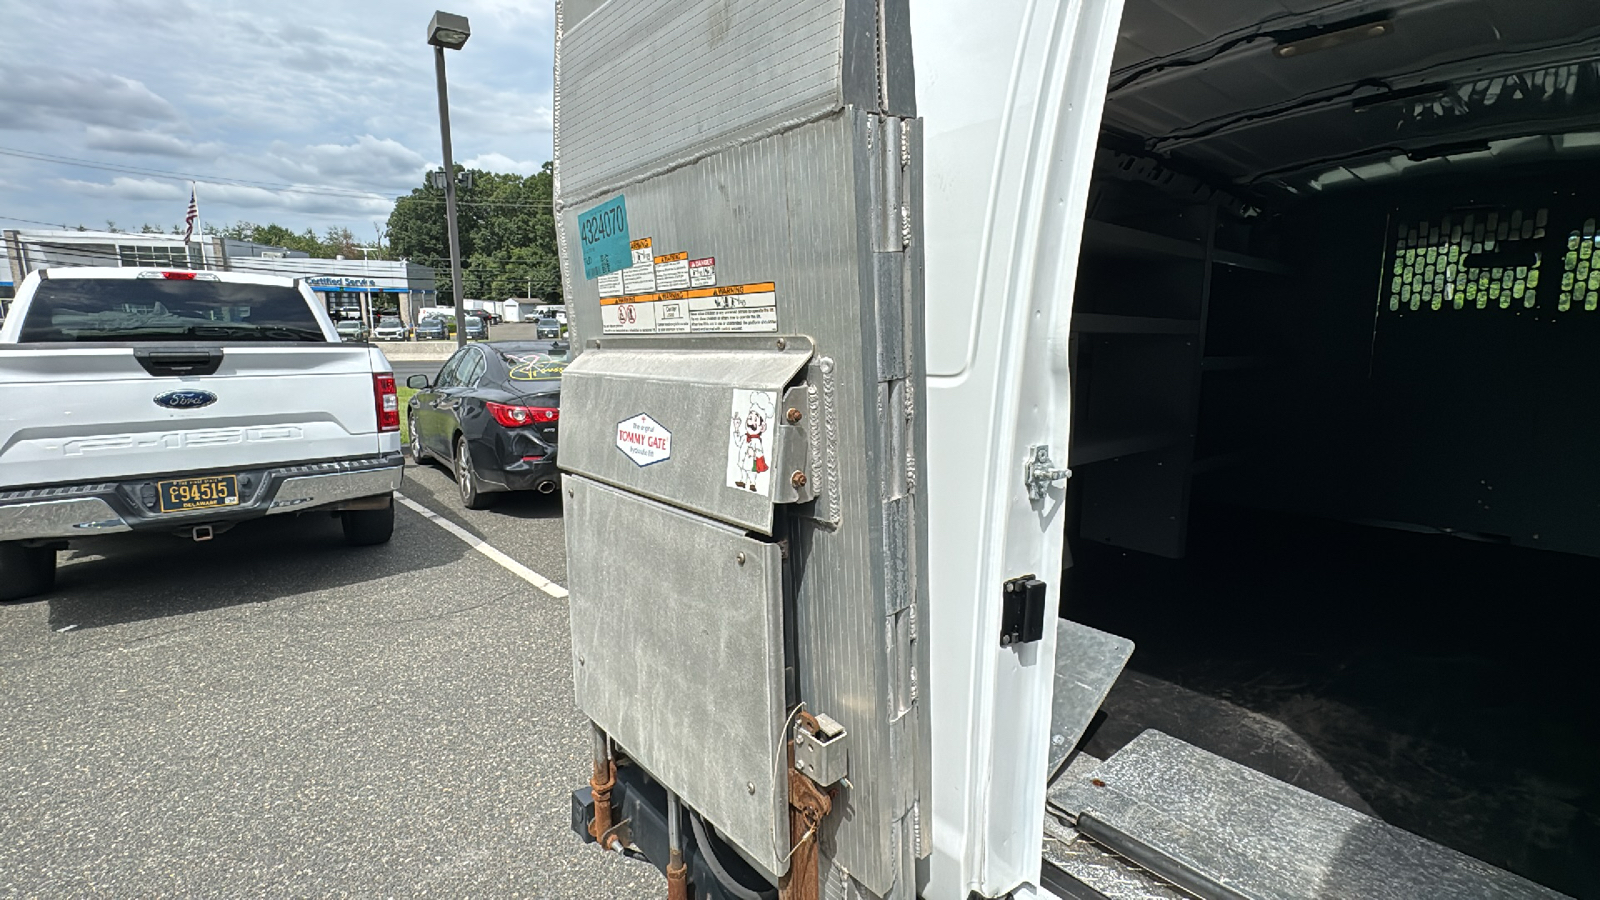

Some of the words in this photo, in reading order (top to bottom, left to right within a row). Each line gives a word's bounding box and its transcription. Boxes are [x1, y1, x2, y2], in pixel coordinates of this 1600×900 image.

[581, 205, 624, 246] 4324070
[631, 239, 649, 249] ARNING
[718, 286, 744, 295] WARNING
[170, 393, 203, 406] Ford
[63, 426, 304, 456] F-150
[619, 429, 646, 446] TOMMY
[647, 436, 667, 451] GATE
[183, 499, 218, 508] DELAWARE
